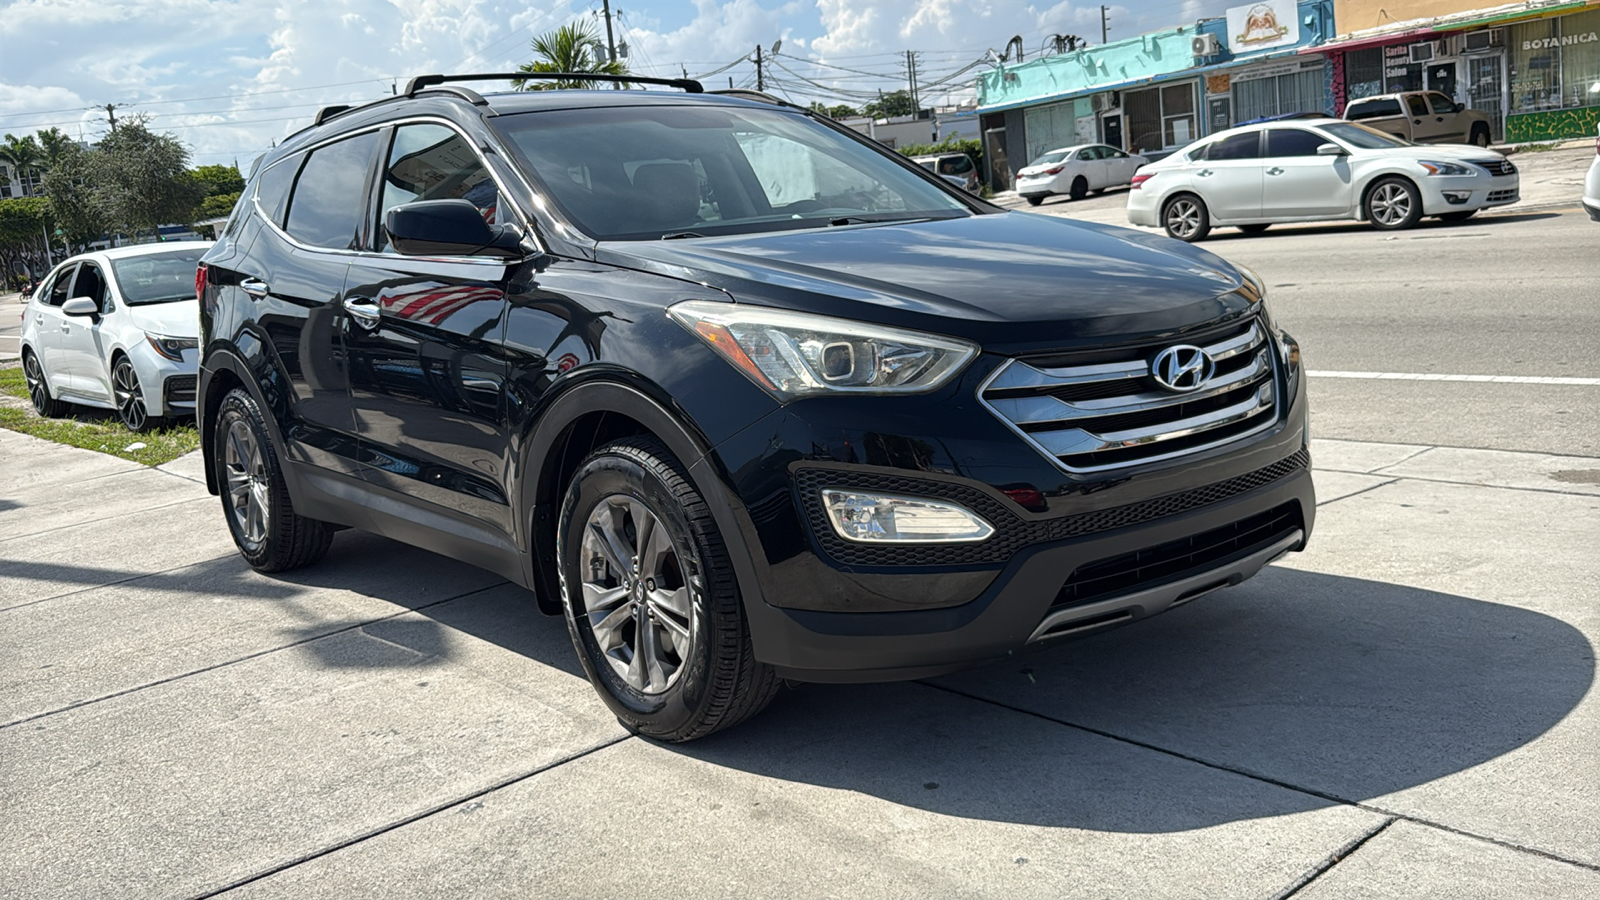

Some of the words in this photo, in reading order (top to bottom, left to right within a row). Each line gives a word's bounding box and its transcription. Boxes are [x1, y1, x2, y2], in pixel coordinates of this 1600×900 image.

[1522, 32, 1598, 50] BOTANICA
[1385, 46, 1407, 57] Sarita
[1386, 56, 1410, 67] Beauty
[1386, 67, 1407, 78] Salon
